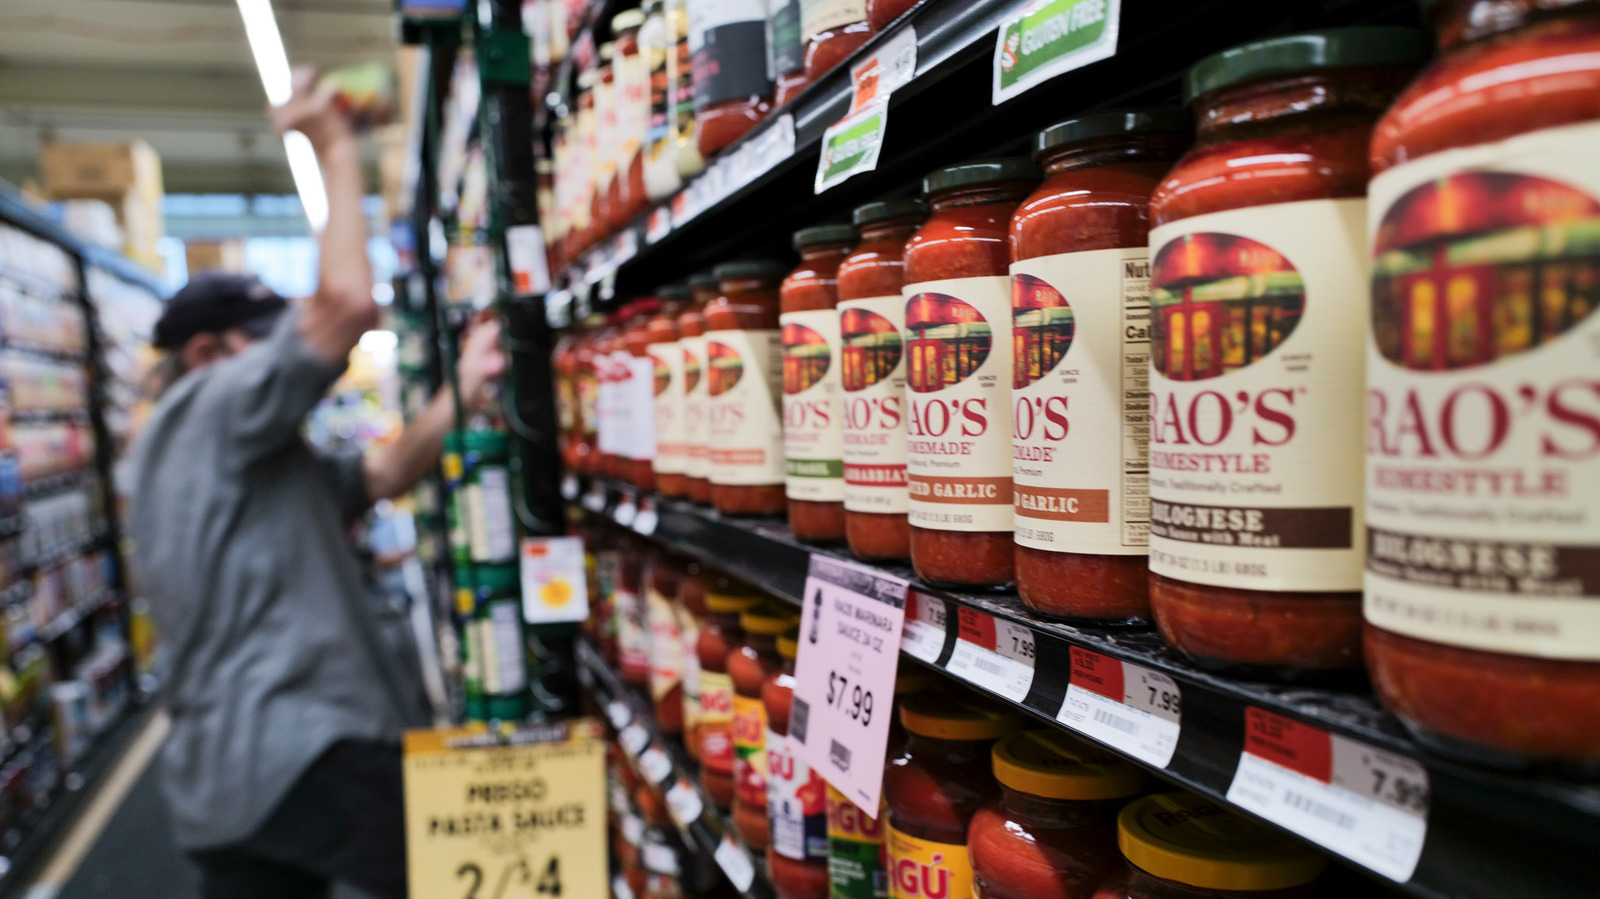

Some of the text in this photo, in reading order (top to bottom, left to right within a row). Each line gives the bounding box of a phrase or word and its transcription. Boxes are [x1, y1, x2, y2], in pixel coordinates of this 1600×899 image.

[1021, 0, 1105, 55] GLUTEN FREE
[1125, 262, 1150, 278] Nut
[1125, 325, 1151, 339] Cal
[843, 396, 902, 431] AO'S
[907, 398, 989, 438] AO'S
[1013, 395, 1071, 442] O'S
[933, 483, 998, 498] GARLIC
[1021, 493, 1080, 514] GARLIC
[1011, 636, 1035, 659] 7.99
[827, 670, 873, 727] $7.99
[1147, 684, 1180, 715] 7.99
